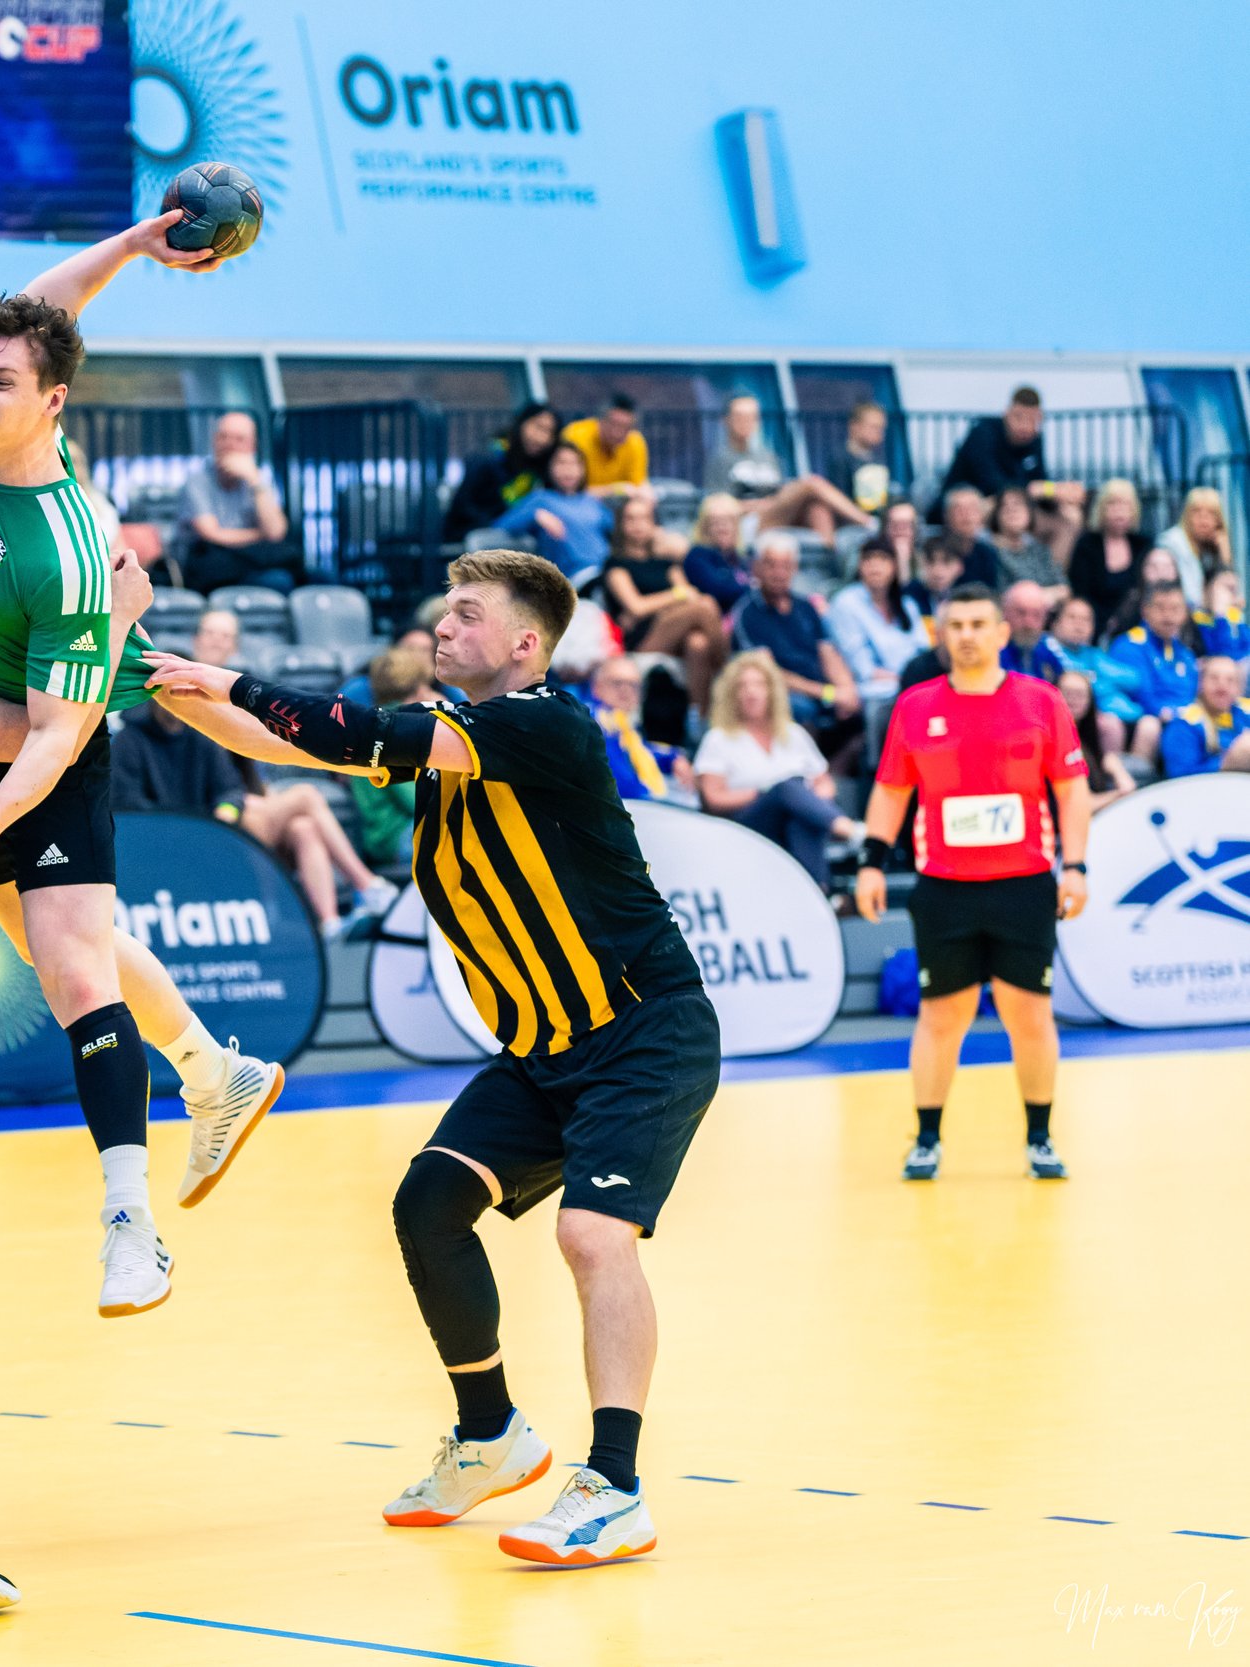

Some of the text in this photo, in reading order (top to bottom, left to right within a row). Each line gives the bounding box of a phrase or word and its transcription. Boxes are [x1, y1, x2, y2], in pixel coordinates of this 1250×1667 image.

[339, 54, 581, 134] Oriam
[489, 153, 567, 179] SPORTS
[357, 178, 598, 207] PERFORMANCE CENTRE
[69, 643, 98, 652] adidas
[36, 855, 69, 867] adidas
[197, 959, 262, 982] SPORTS
[696, 936, 809, 986] BALL
[1130, 963, 1233, 988] SCOTTISH
[221, 979, 287, 1002] CENTRE
[81, 1032, 117, 1056] SELECT
